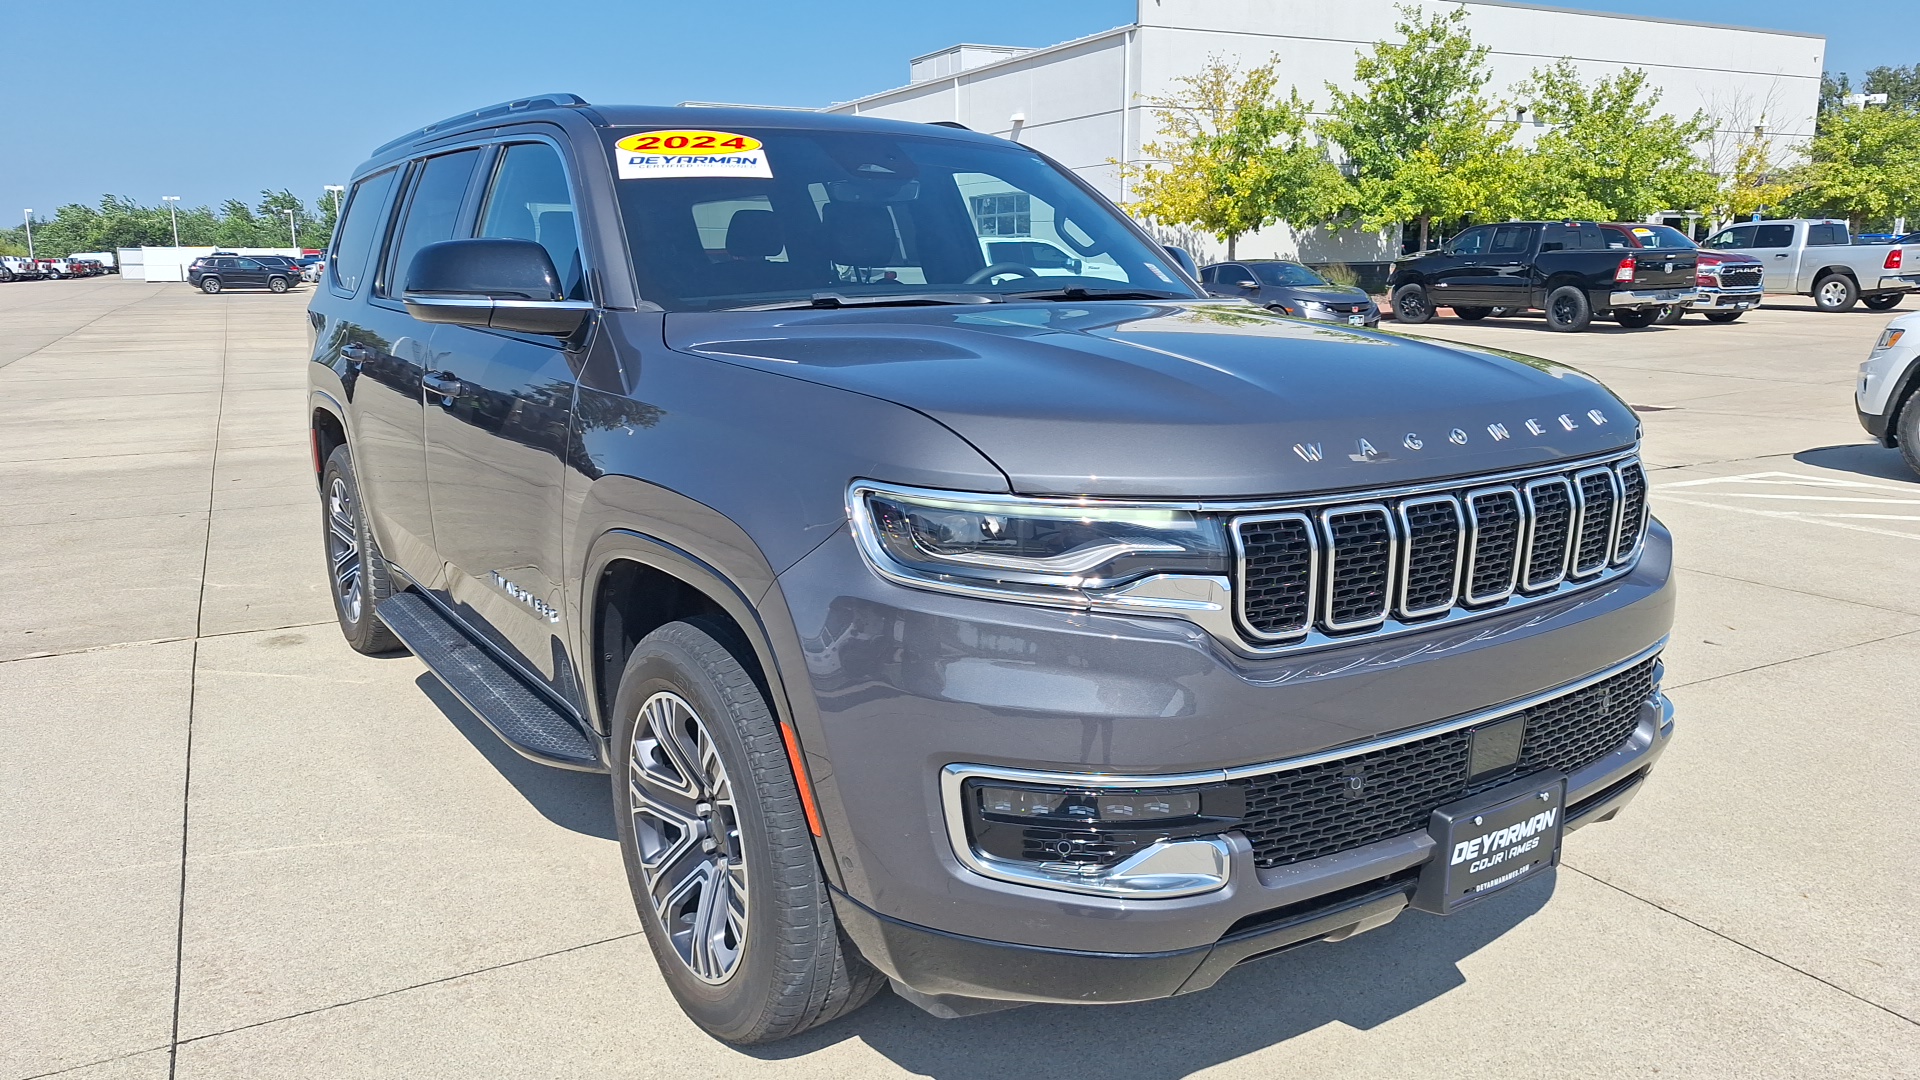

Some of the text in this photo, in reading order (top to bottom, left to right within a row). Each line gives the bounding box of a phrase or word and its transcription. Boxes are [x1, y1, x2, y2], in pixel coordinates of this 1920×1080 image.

[634, 136, 746, 150] 2024
[628, 156, 758, 165] DEYARMAN
[1293, 408, 1608, 462] WAGONEER
[1450, 807, 1557, 866] DEYARMAN
[1469, 836, 1540, 874] CDJR AMES
[1475, 863, 1530, 892] DEYARMANAMES.COM
